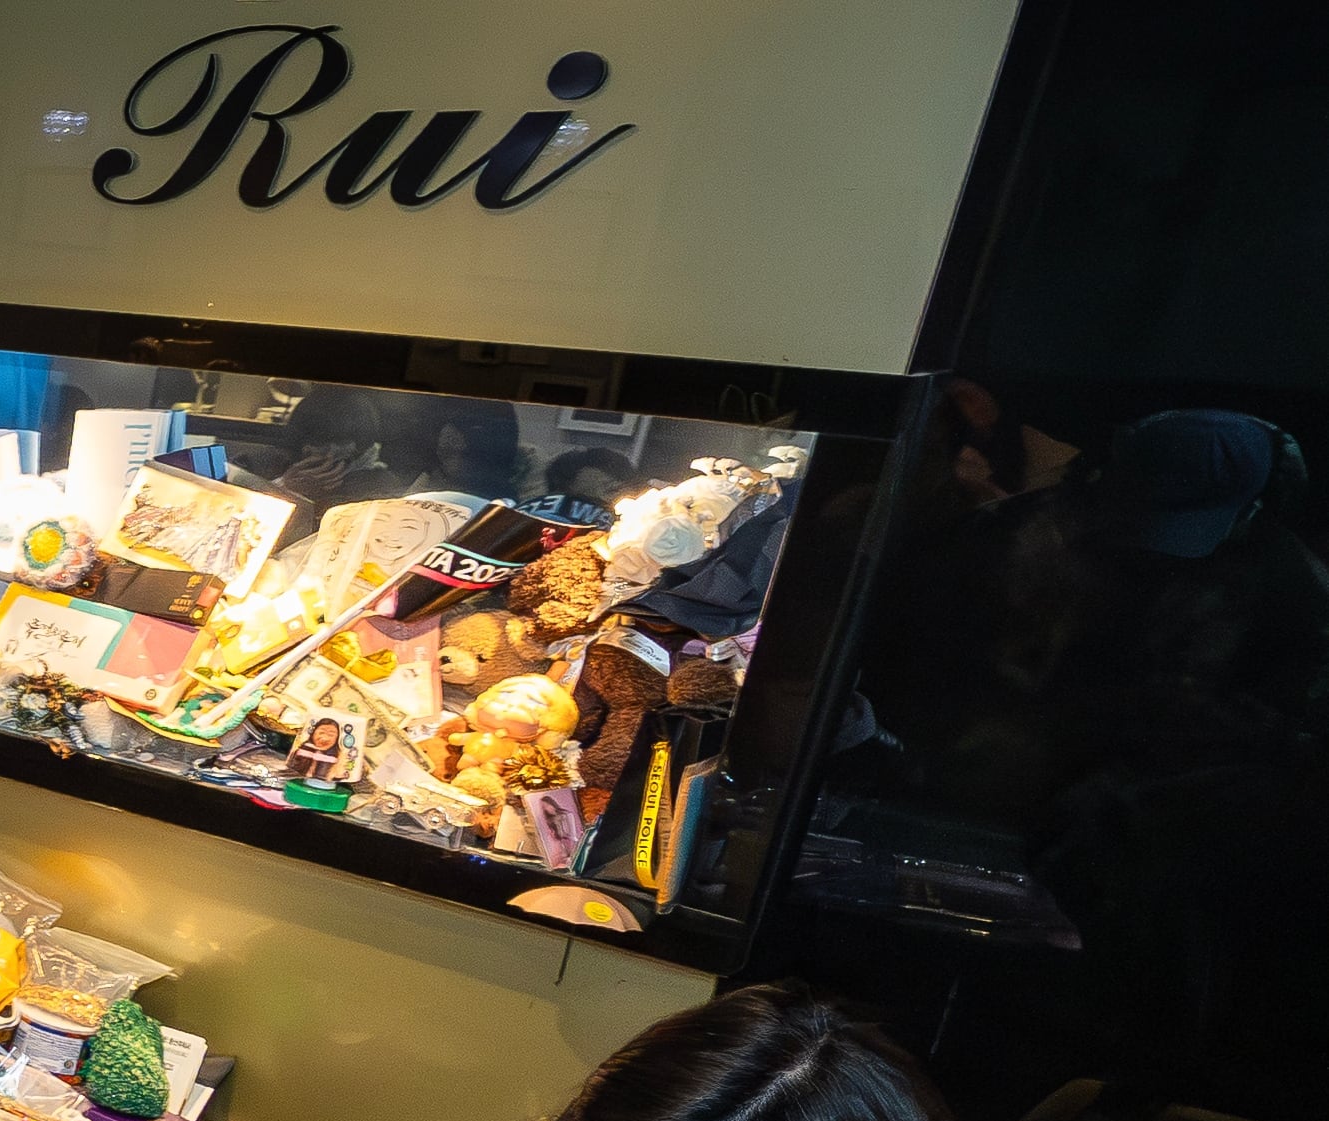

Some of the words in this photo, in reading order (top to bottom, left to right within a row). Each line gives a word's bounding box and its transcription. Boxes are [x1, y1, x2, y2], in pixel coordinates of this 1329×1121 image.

[93, 25, 637, 209] Rui
[645, 765, 662, 812] SEOUL
[637, 817, 653, 868] POLICE
